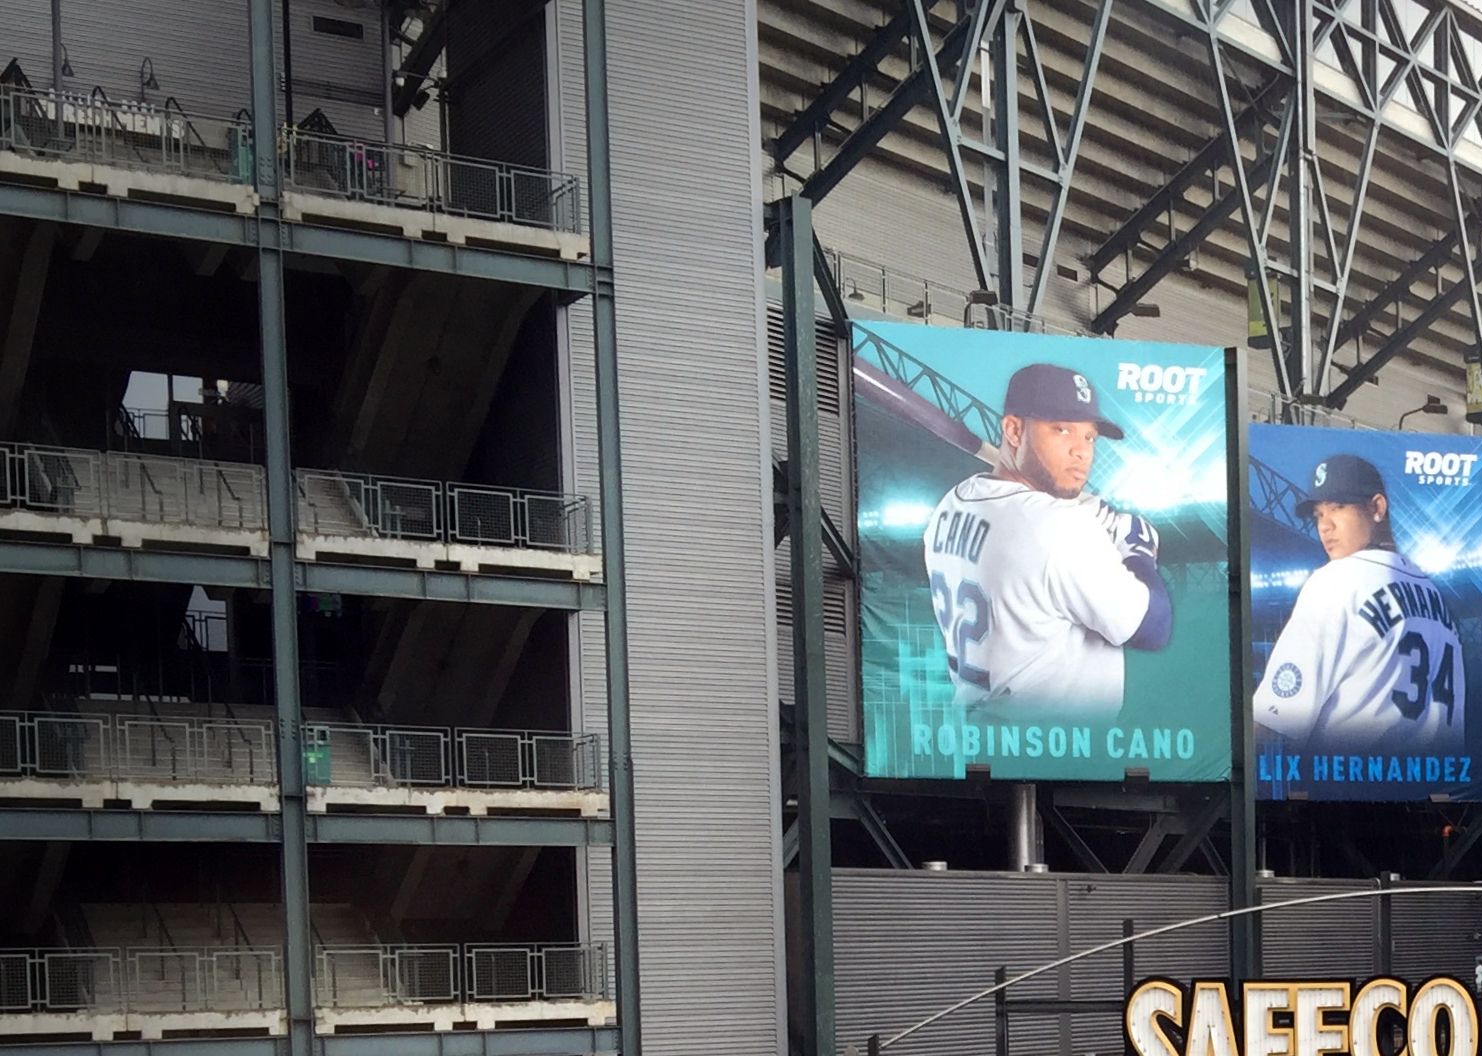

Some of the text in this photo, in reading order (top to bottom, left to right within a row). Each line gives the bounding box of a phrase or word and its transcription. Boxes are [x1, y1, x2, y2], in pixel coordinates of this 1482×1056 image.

[1117, 362, 1207, 397] ROOT
[1134, 392, 1196, 406] SPORTS
[1405, 450, 1477, 476] ROOT
[1418, 475, 1470, 487] SPORTS
[933, 510, 991, 564] CANO
[931, 569, 991, 692] 22
[1392, 631, 1455, 727] 34
[914, 723, 1195, 759] ROBINSON CANO
[1313, 755, 1472, 782] HERNANDEZ
